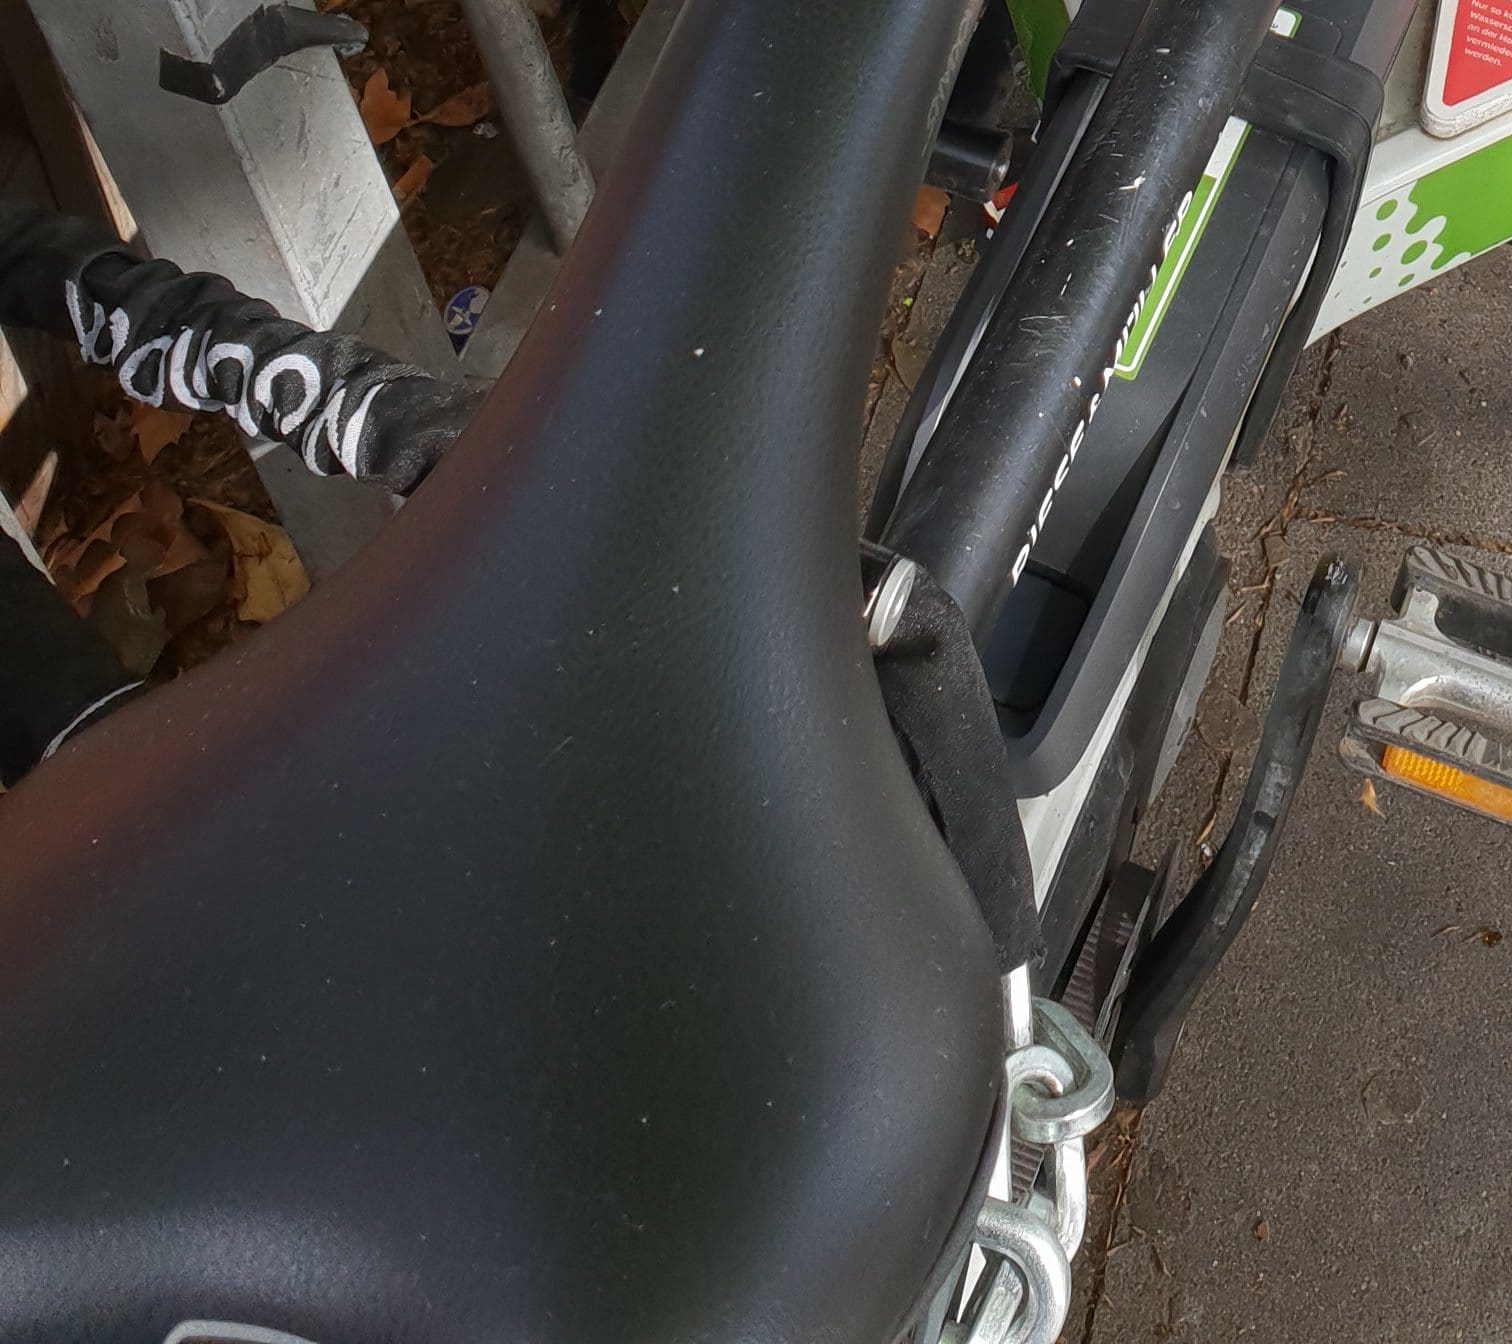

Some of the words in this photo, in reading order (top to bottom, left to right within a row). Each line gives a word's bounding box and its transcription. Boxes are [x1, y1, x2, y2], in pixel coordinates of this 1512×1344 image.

[1490, 5, 1502, 16] so
[1467, 23, 1481, 35] an
[1482, 26, 1498, 40] der
[1464, 47, 1503, 67] werden.
